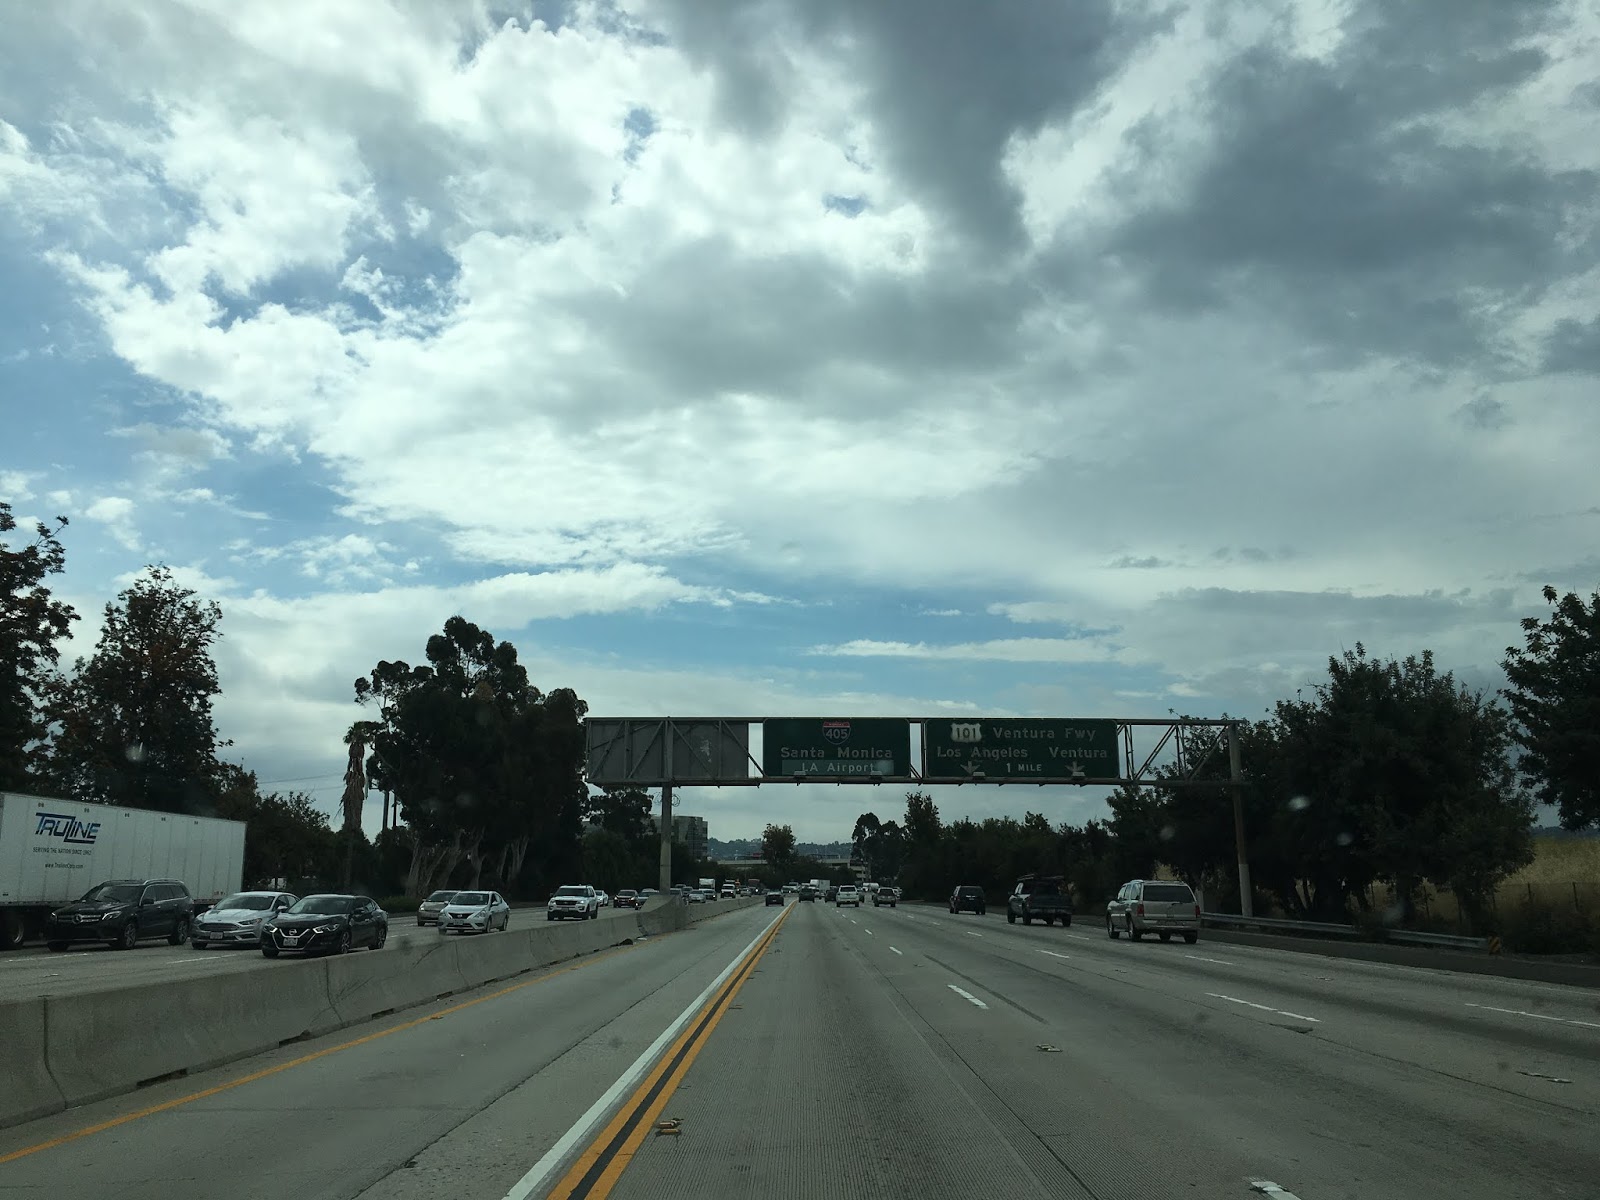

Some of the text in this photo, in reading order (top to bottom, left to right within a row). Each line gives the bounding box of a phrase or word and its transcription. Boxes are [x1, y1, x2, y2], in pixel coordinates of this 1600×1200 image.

[825, 728, 848, 739] 405
[956, 727, 1096, 741] 101 Ventura Fwy
[780, 746, 893, 758] Santa Monica
[937, 746, 1028, 761] Los Angeles
[1049, 746, 1107, 758] Ventura
[802, 762, 874, 773] LA Airport
[1018, 764, 1042, 772] MILE
[35, 812, 101, 844] TRULINE
